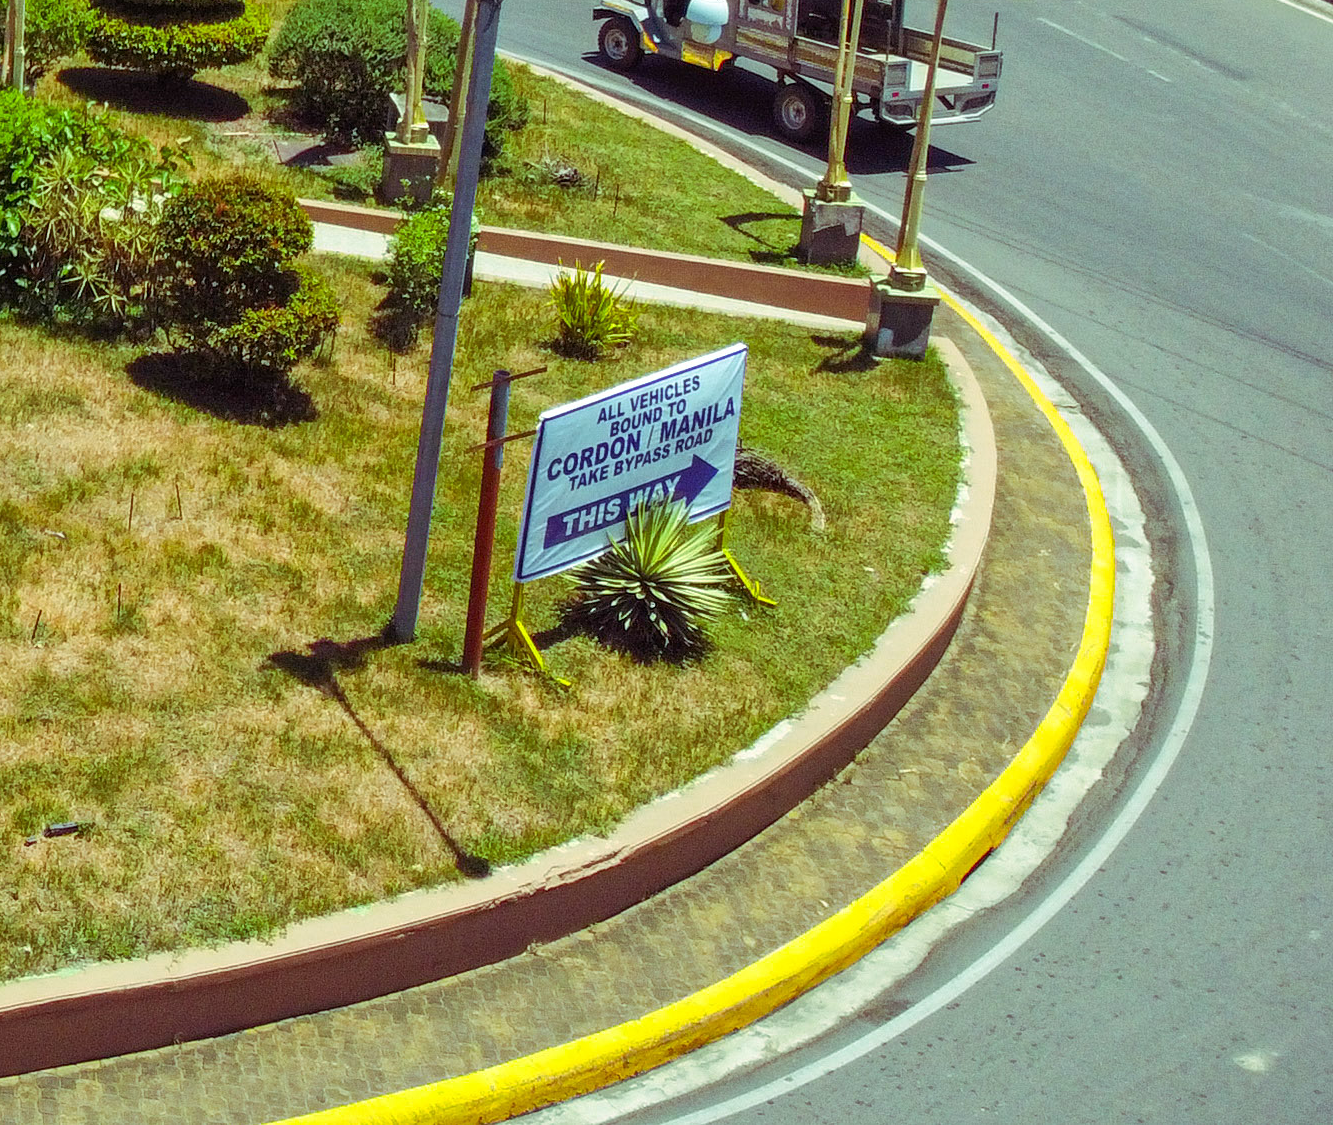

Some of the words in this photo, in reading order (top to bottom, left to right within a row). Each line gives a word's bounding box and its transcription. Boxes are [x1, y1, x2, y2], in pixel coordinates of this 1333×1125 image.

[596, 401, 625, 425] ALL
[629, 375, 701, 412] VEHICLES
[609, 407, 663, 438] BOUND
[666, 398, 687, 419] TO
[546, 430, 642, 482] CORDON
[659, 396, 735, 445] MANILA
[569, 466, 609, 492] TAKE
[614, 445, 671, 477] BYPASS
[674, 428, 713, 456] ROAD
[561, 499, 627, 537] THIS
[629, 475, 682, 515] WAY
